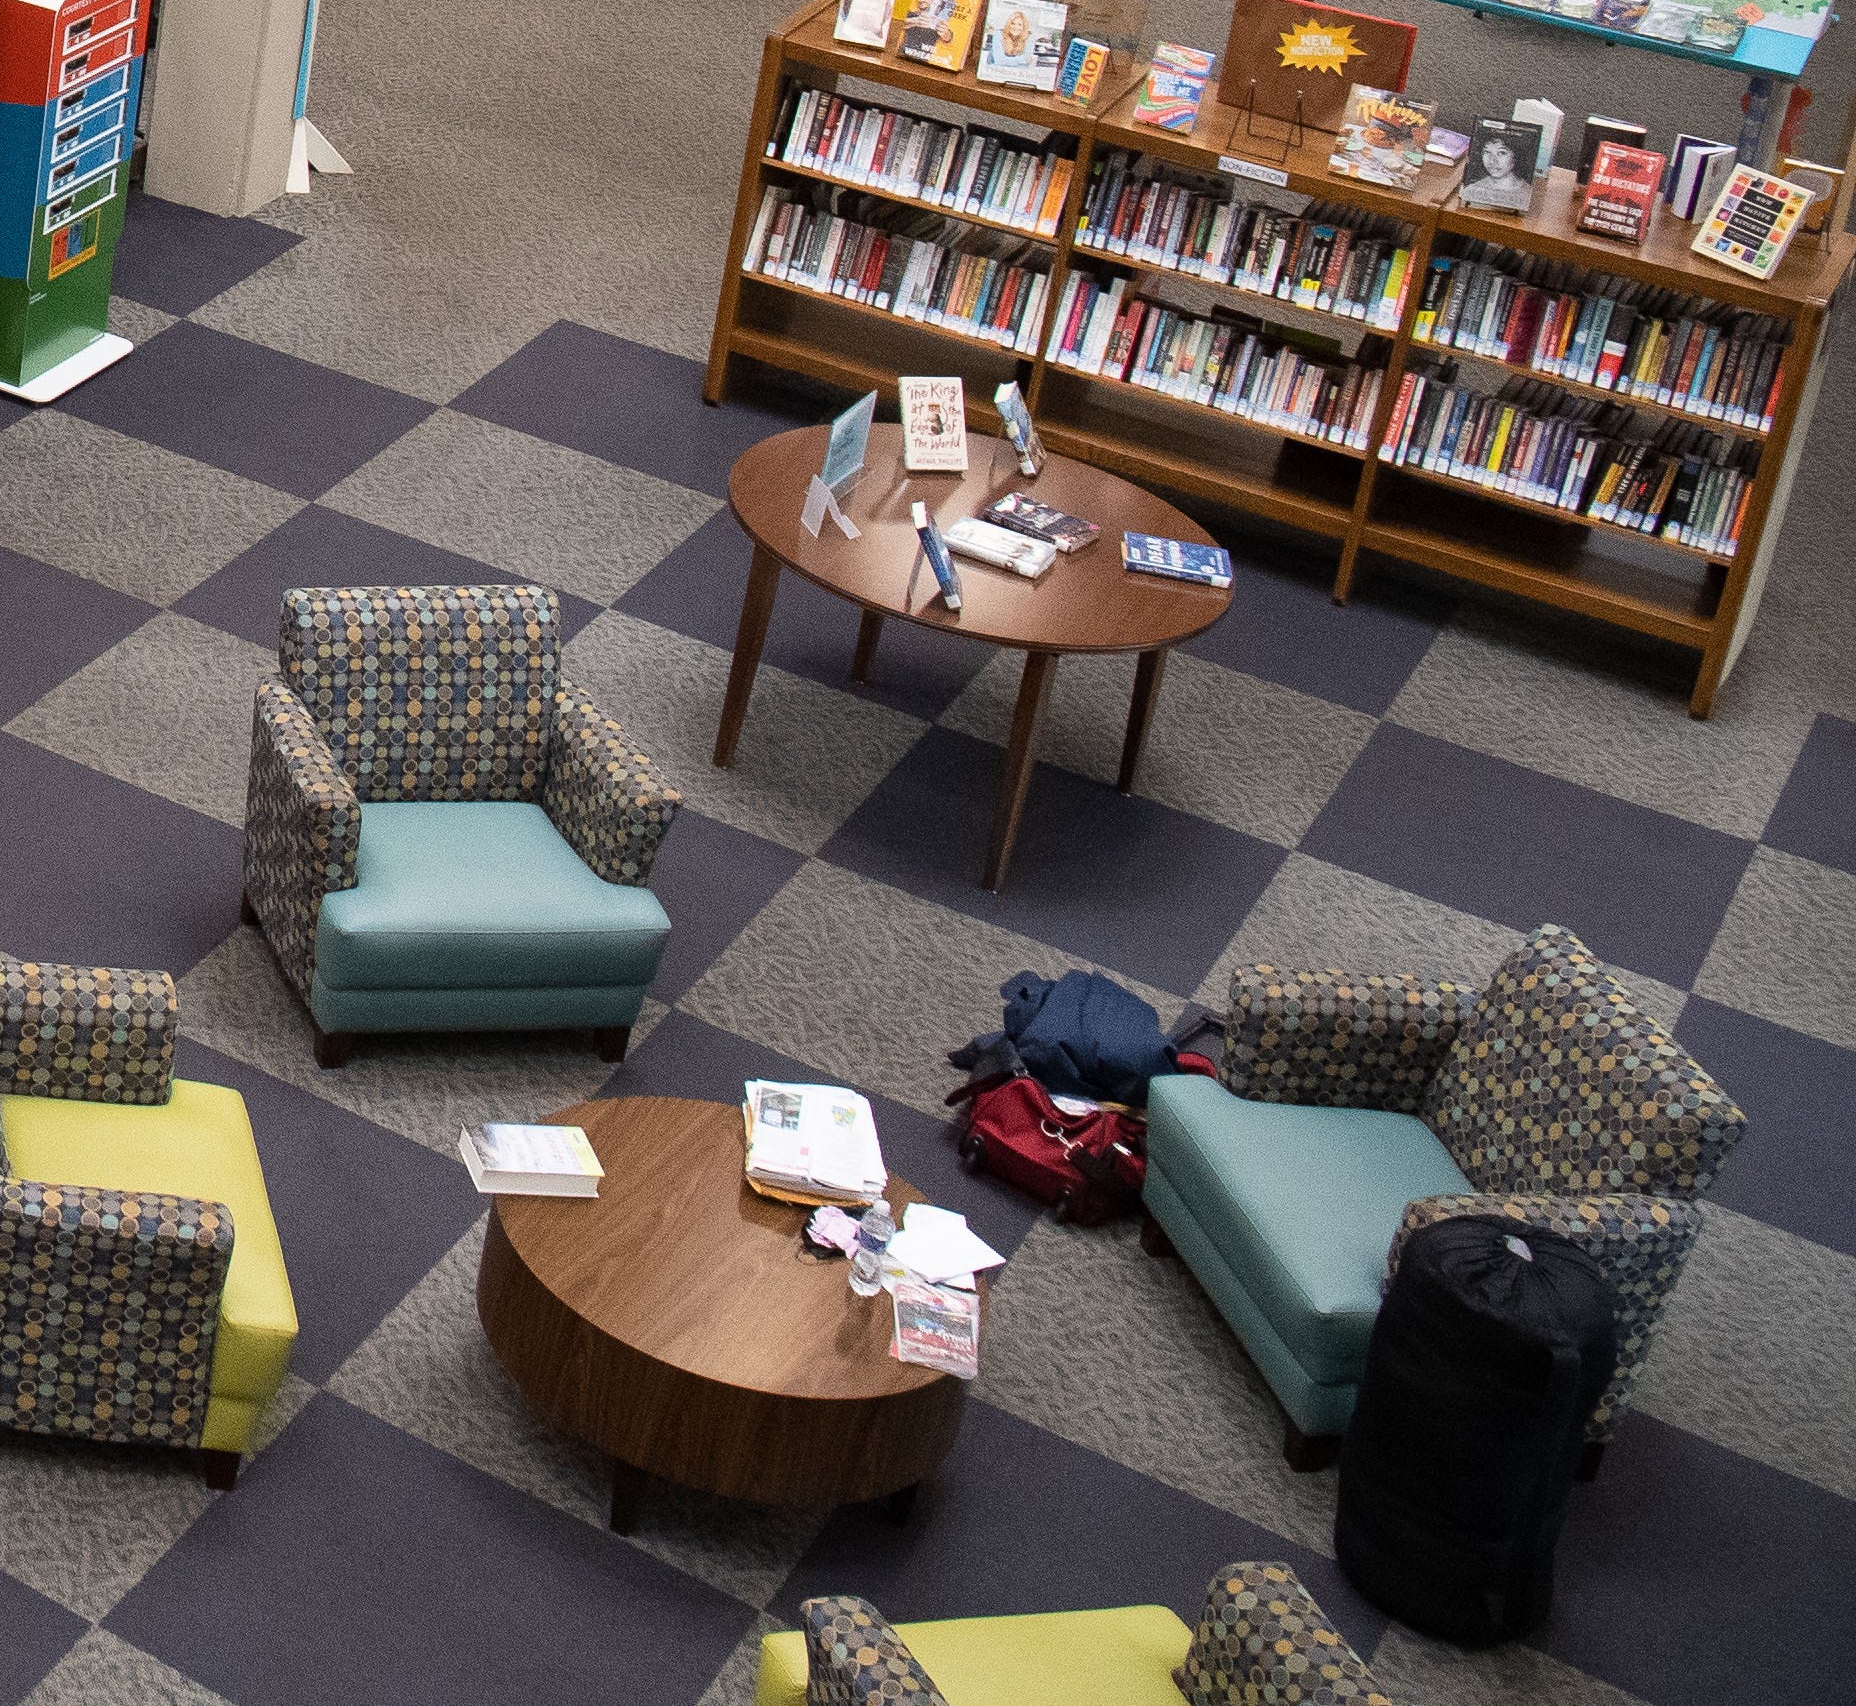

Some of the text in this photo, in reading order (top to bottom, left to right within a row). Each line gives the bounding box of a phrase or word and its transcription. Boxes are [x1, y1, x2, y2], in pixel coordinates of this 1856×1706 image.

[1299, 34, 1332, 47] NEW
[1290, 45, 1345, 58] NONFICTION
[1082, 47, 1101, 96] LOVE
[1218, 157, 1286, 184] NON-FICTION
[1611, 176, 1651, 194] DICTATORS
[907, 382, 960, 404] The King
[911, 403, 925, 415] at
[946, 420, 958, 434] of
[929, 435, 961, 451] World
